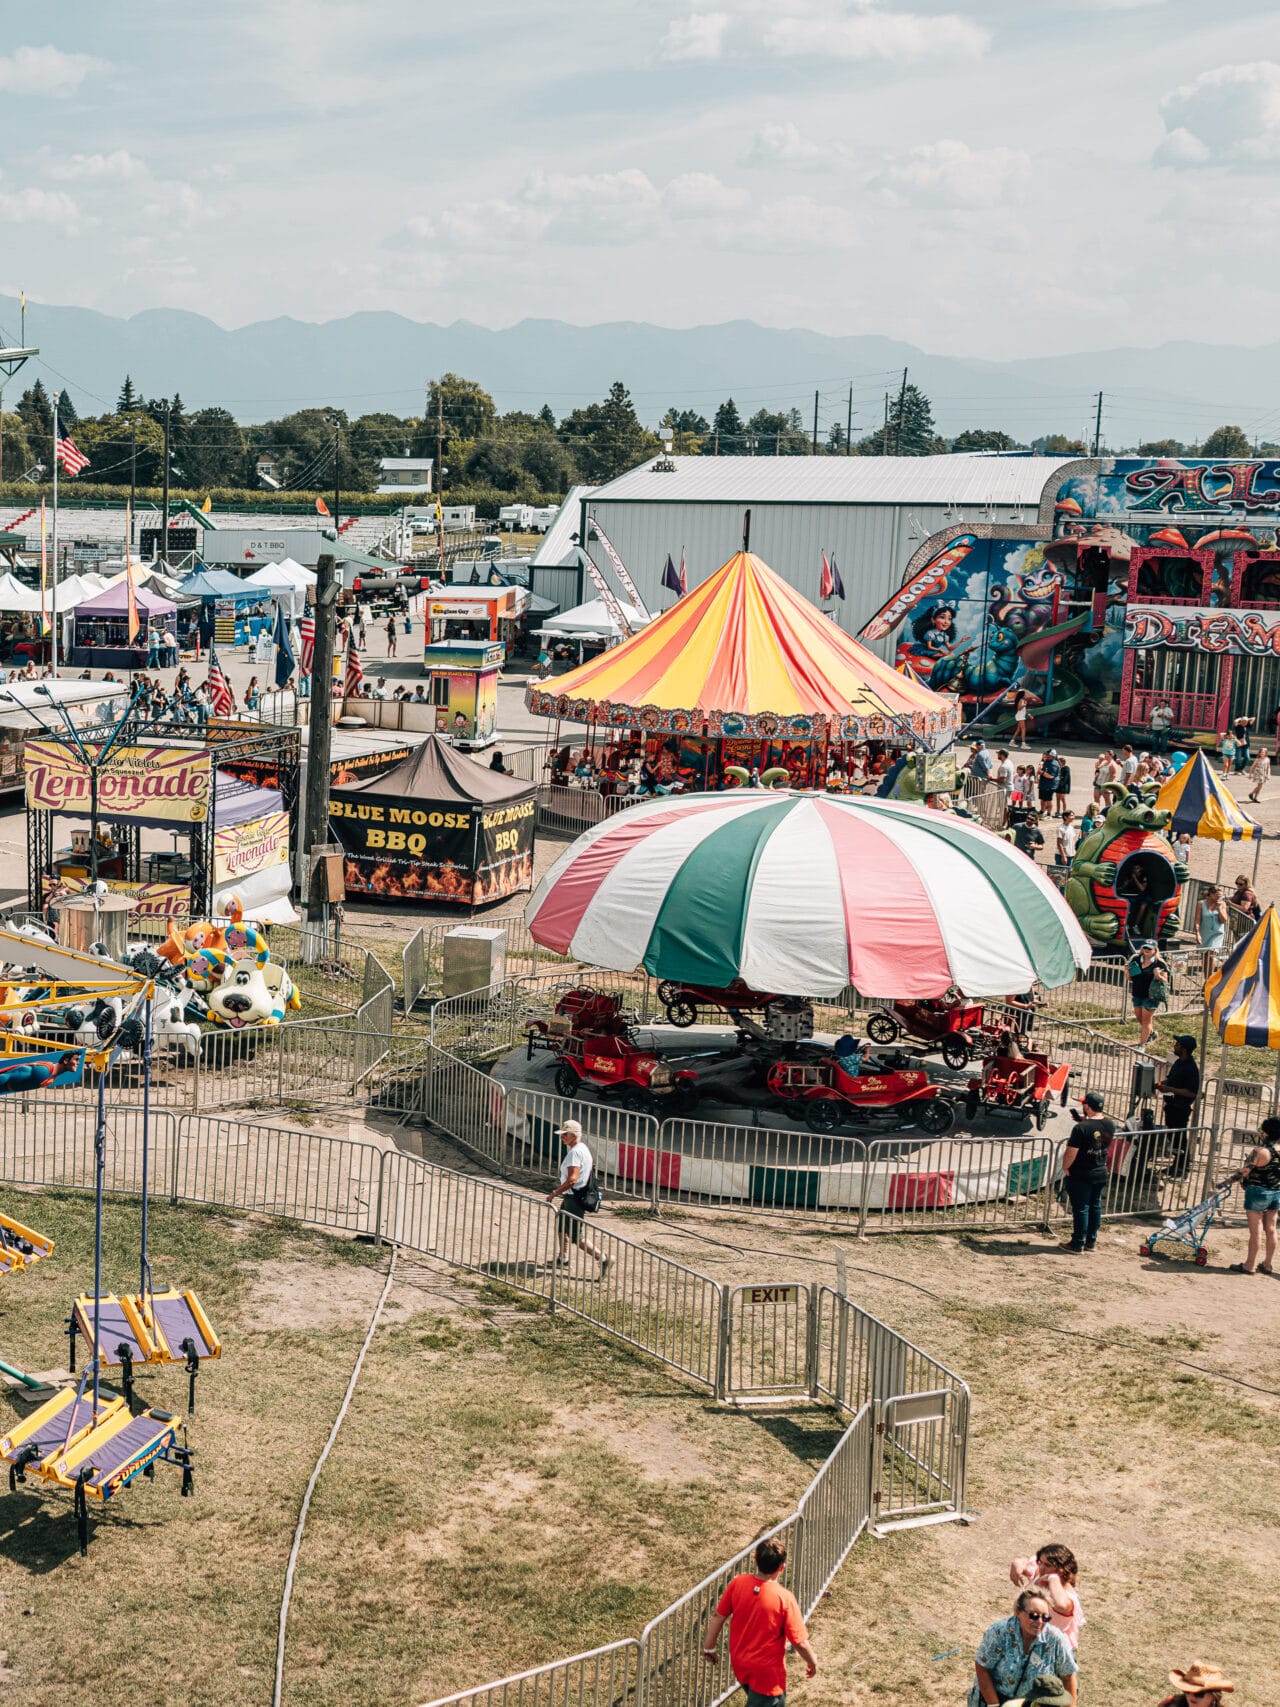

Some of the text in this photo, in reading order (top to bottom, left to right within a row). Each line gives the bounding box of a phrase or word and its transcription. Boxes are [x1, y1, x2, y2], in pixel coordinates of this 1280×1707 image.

[1125, 462, 1280, 513] AL
[882, 558, 954, 623] POPCORN
[29, 766, 210, 807] Lemonade
[110, 768, 146, 777] Squeezed
[328, 800, 470, 829] BLUE MOOSE
[483, 800, 535, 830] BLUE MOOSE
[366, 829, 427, 857] BBQ
[495, 829, 519, 852] BBQ
[226, 835, 279, 876] Lemonade
[1223, 1083, 1257, 1097] NTRANCE
[752, 1288, 790, 1303] EXIT
[111, 1444, 164, 1494] SUPERMAN
